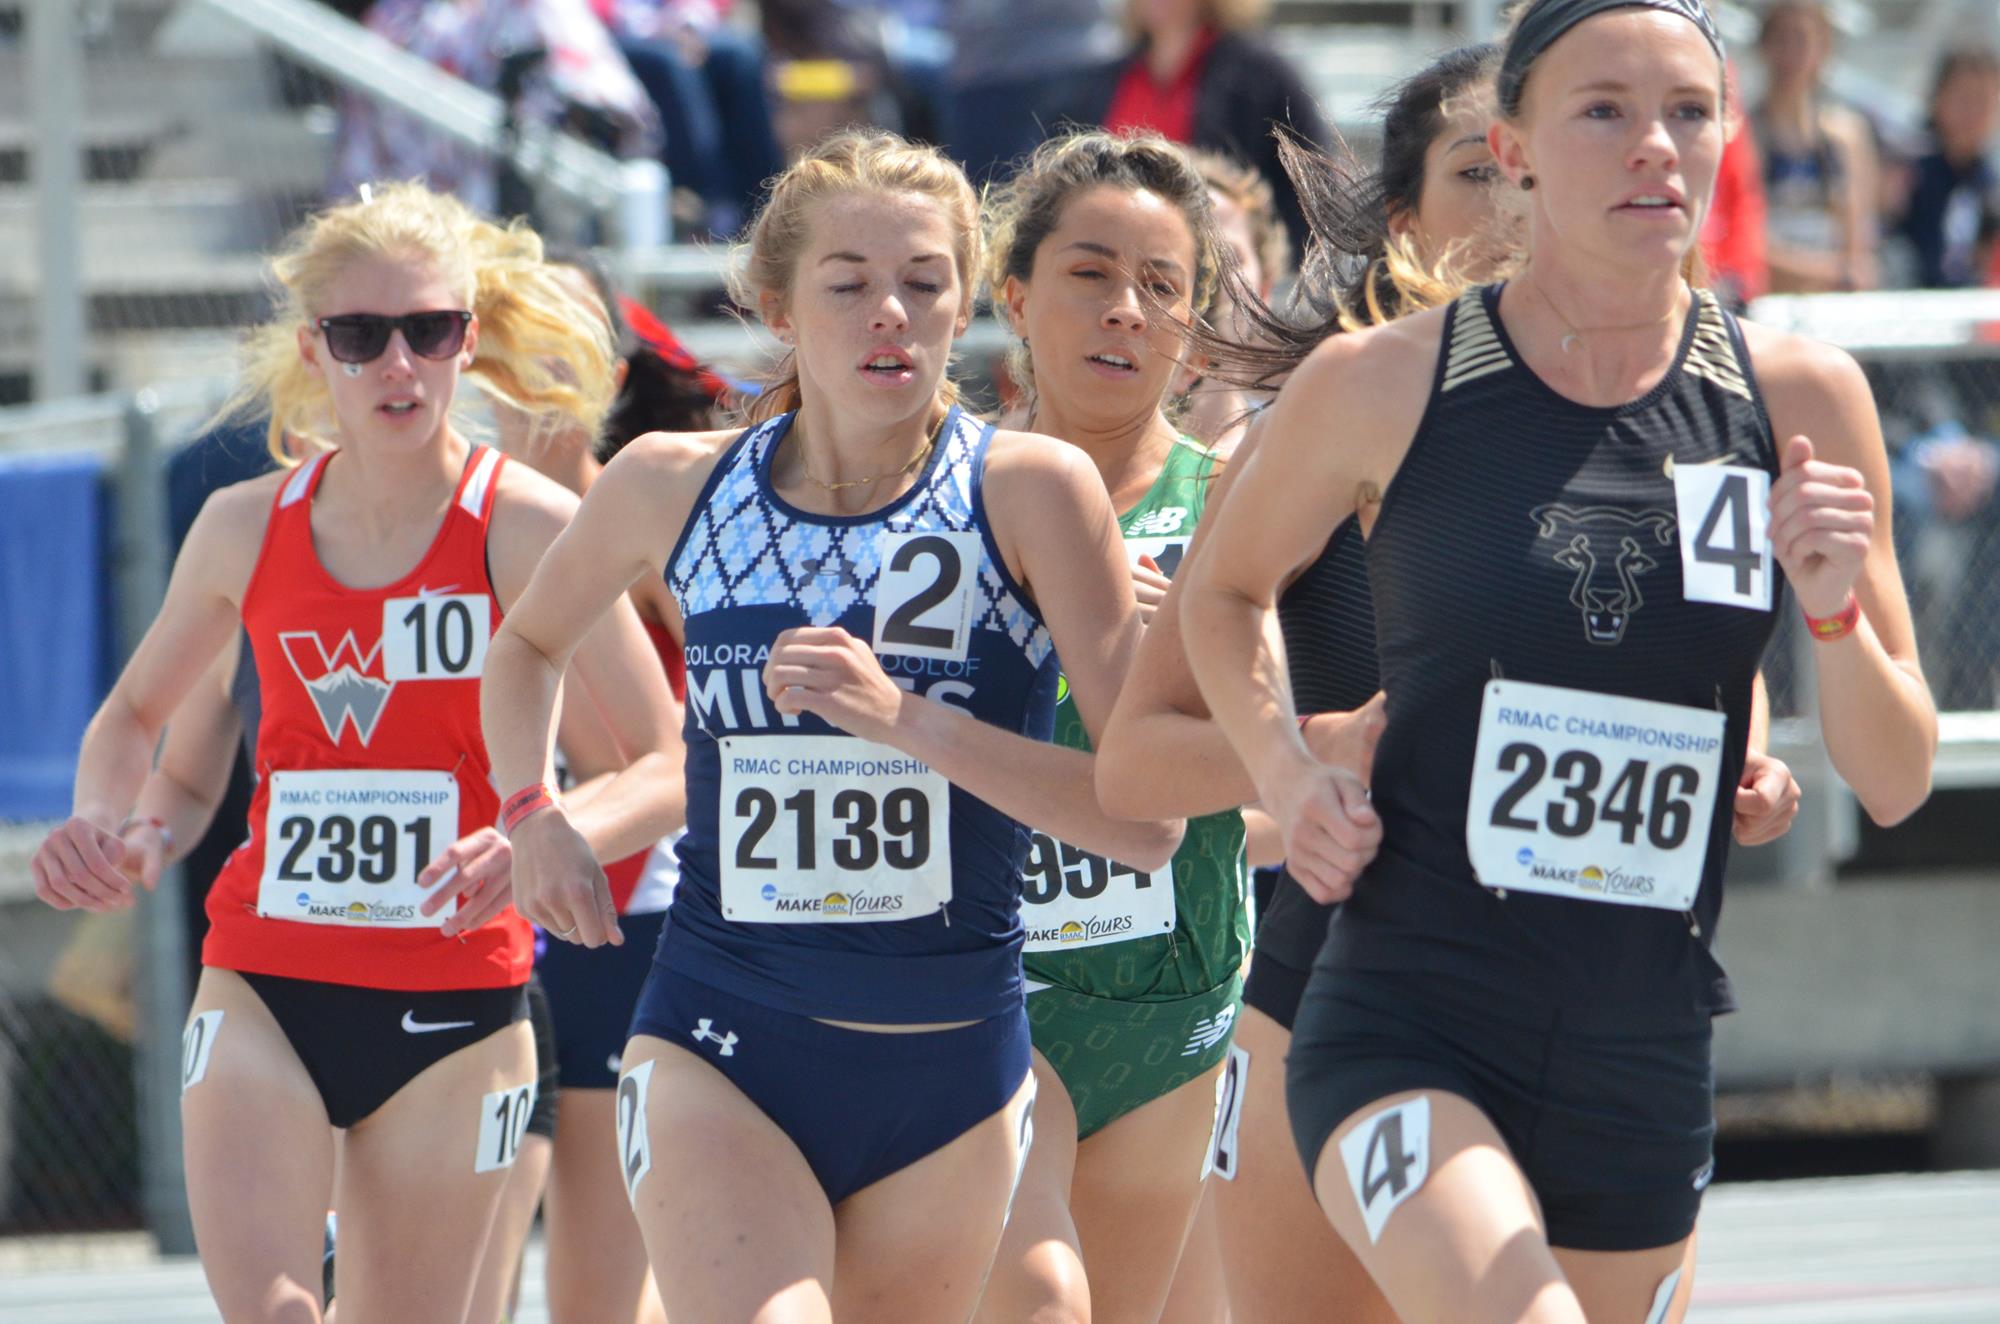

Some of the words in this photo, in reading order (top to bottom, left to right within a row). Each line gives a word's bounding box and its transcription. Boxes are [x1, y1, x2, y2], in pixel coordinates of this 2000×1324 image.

[1692, 474, 1761, 597] 4
[882, 535, 961, 650] 2
[403, 599, 474, 675] 10
[684, 644, 770, 666] COLORA
[685, 668, 976, 729] MIS
[1497, 707, 1560, 733] RMAC
[1565, 716, 1720, 754] CHAMPIONSHIP
[279, 789, 322, 806] RMAC
[325, 789, 451, 806] CHAMPIONSHIP
[733, 758, 781, 775] RMAC
[787, 758, 930, 777] CHAMPIONSHI
[1490, 741, 1701, 851] 2346
[277, 814, 432, 885] 2391
[735, 787, 931, 871] 2139
[308, 904, 347, 918] MAKE
[367, 900, 416, 921] YOURS
[775, 898, 823, 912] MAKE
[847, 890, 904, 915] YOURS
[1530, 865, 1577, 883] MAKE
[1603, 866, 1656, 895] YOURS
[1026, 928, 1060, 942] AKE
[1081, 915, 1133, 941] YOURS
[496, 1087, 530, 1164] 10
[619, 1076, 643, 1193] 2
[1361, 1110, 1416, 1212] 4
